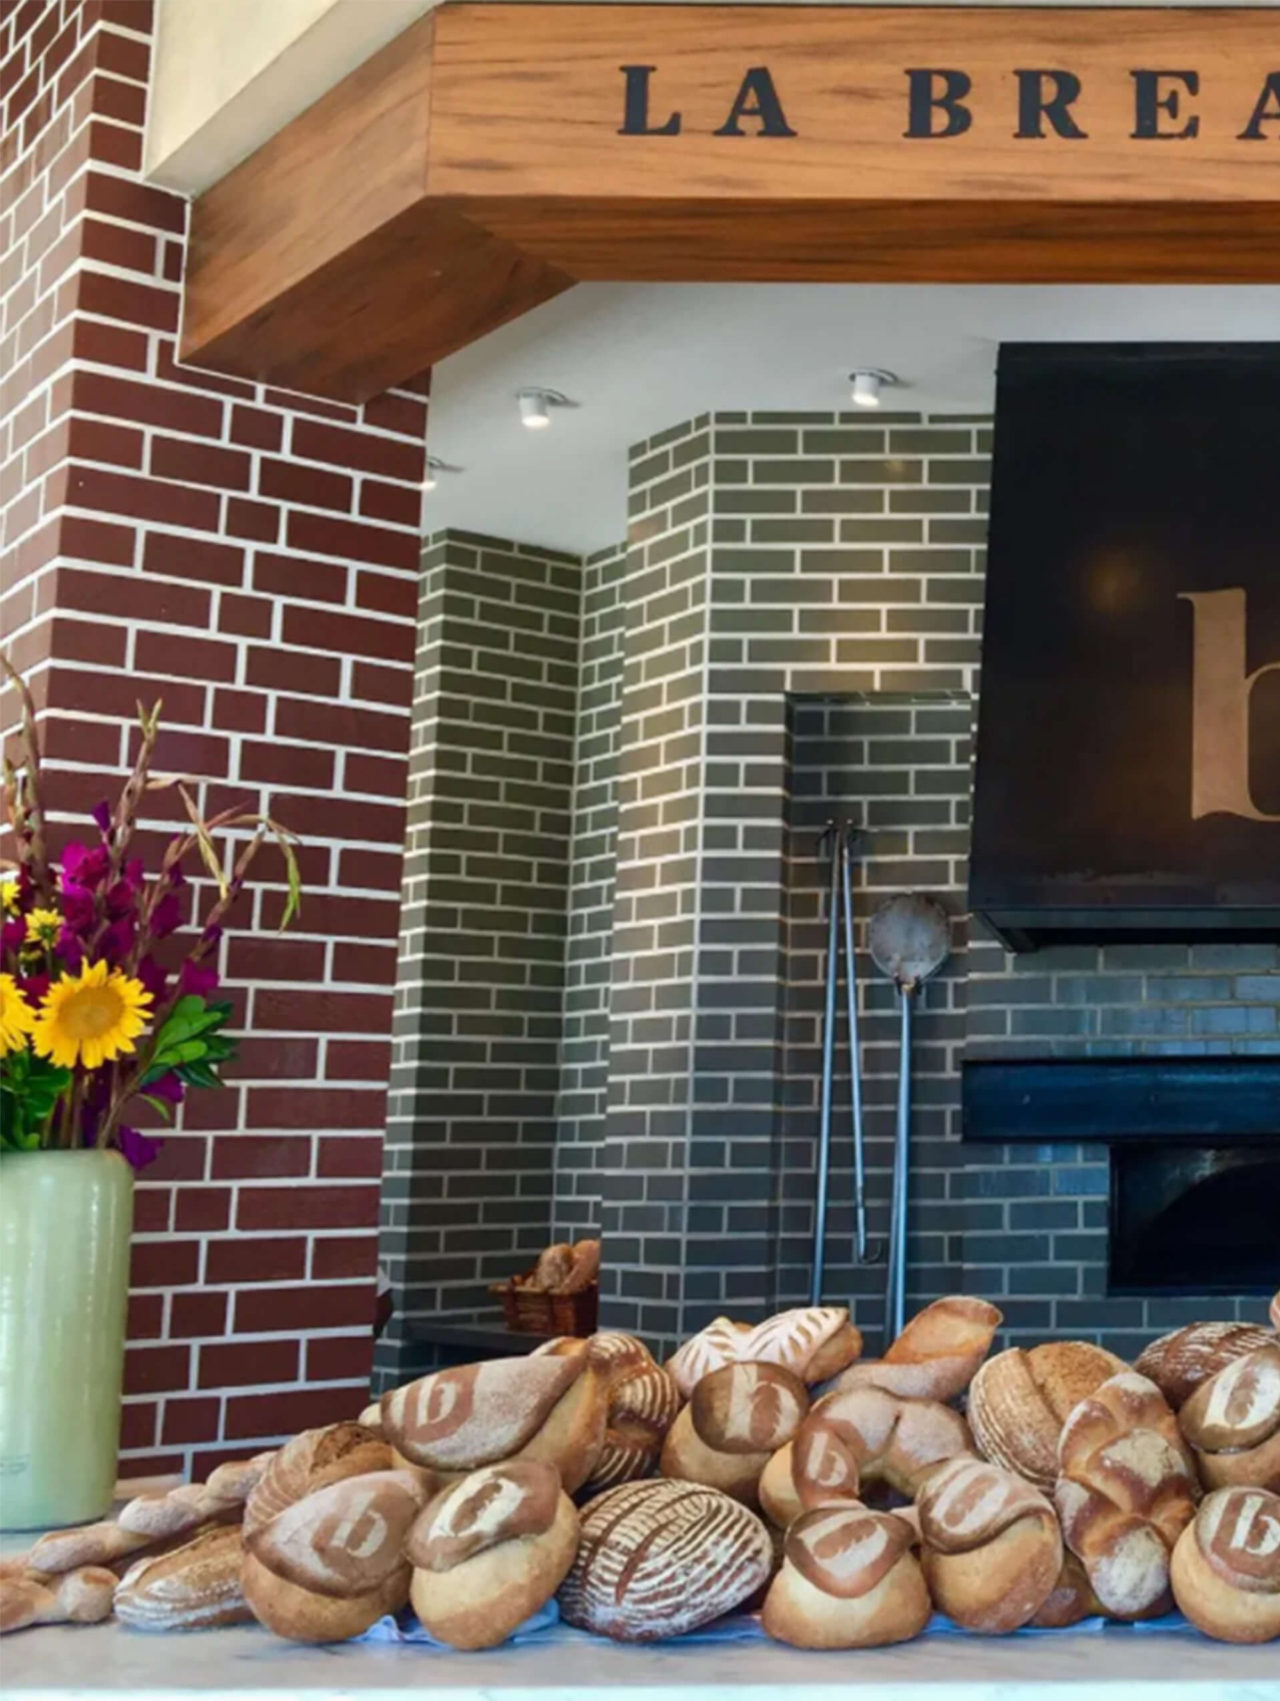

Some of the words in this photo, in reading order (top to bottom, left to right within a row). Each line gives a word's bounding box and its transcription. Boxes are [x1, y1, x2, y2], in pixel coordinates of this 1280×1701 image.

[619, 66, 797, 138] LA
[418, 1374, 461, 1430] b
[724, 1364, 799, 1442] b
[806, 1432, 849, 1488] b
[330, 1491, 388, 1558] b
